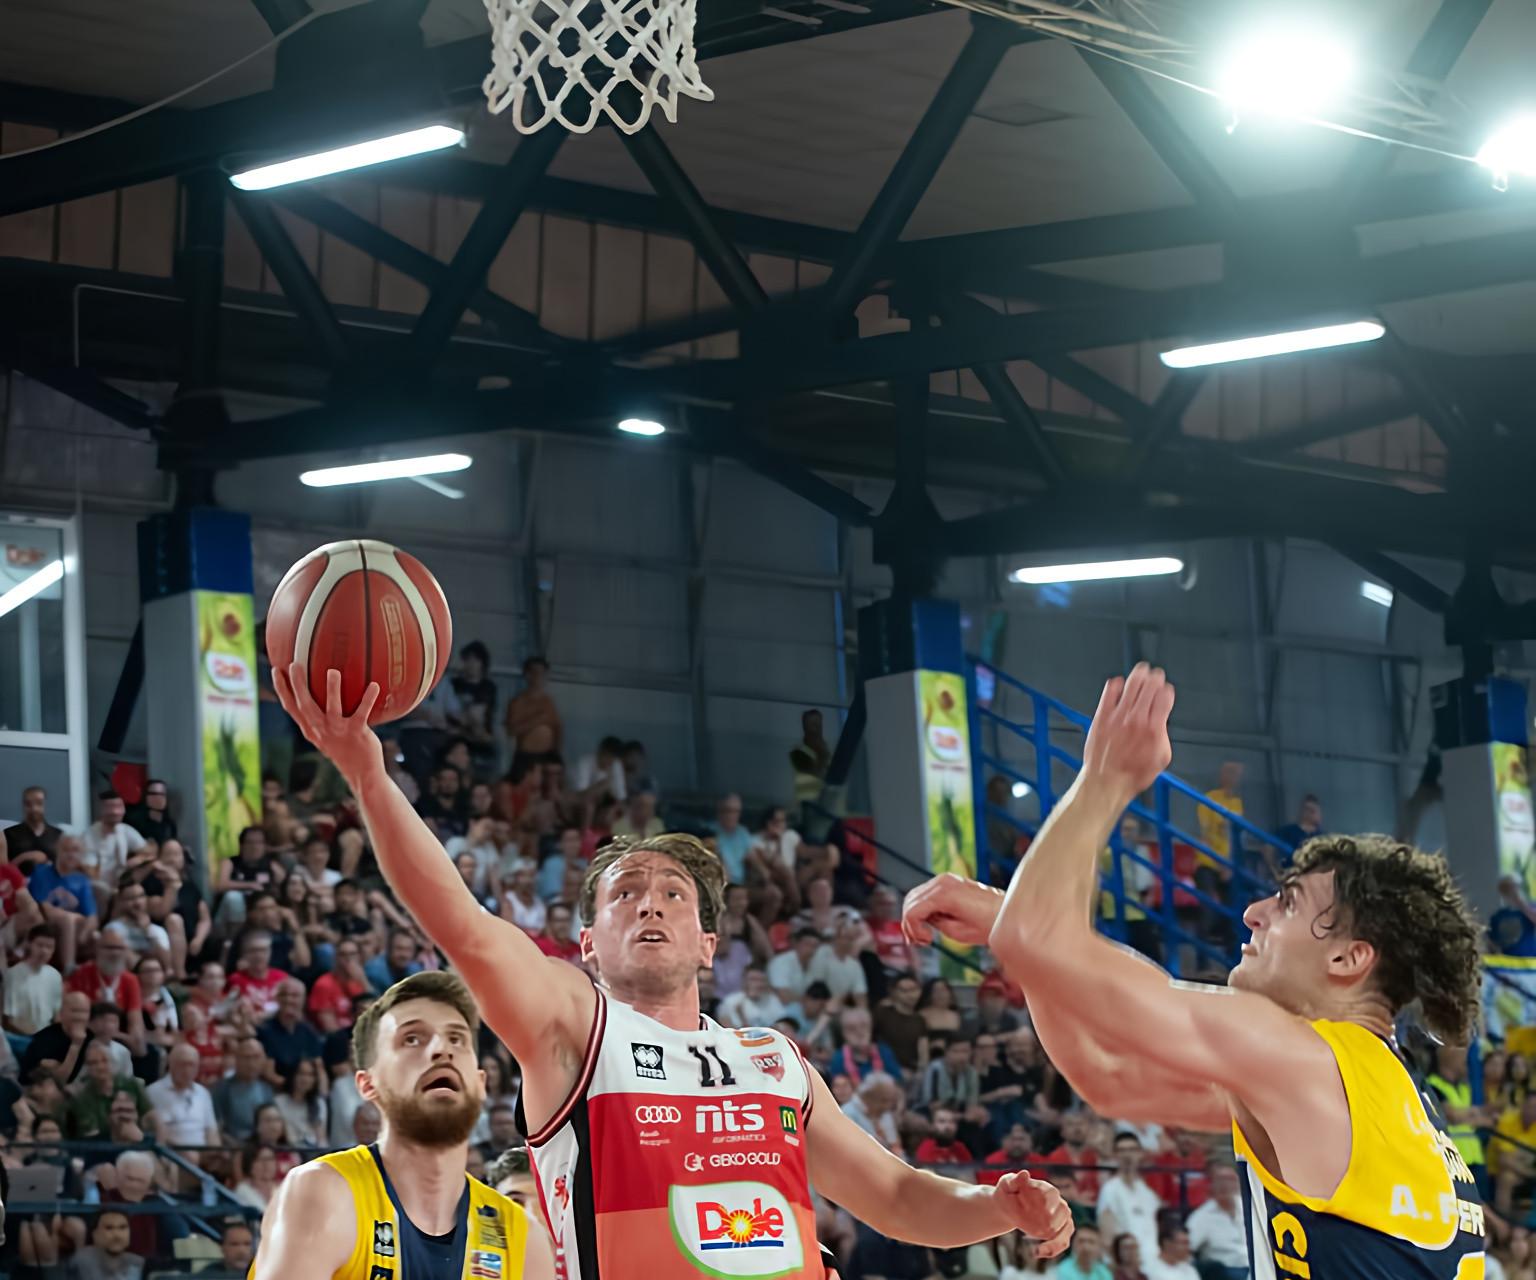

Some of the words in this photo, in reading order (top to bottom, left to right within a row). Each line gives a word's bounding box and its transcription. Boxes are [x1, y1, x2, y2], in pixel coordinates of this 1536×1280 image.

[688, 1045, 737, 1088] 11
[695, 1100, 765, 1133] nts
[696, 1198, 785, 1243] Dole
